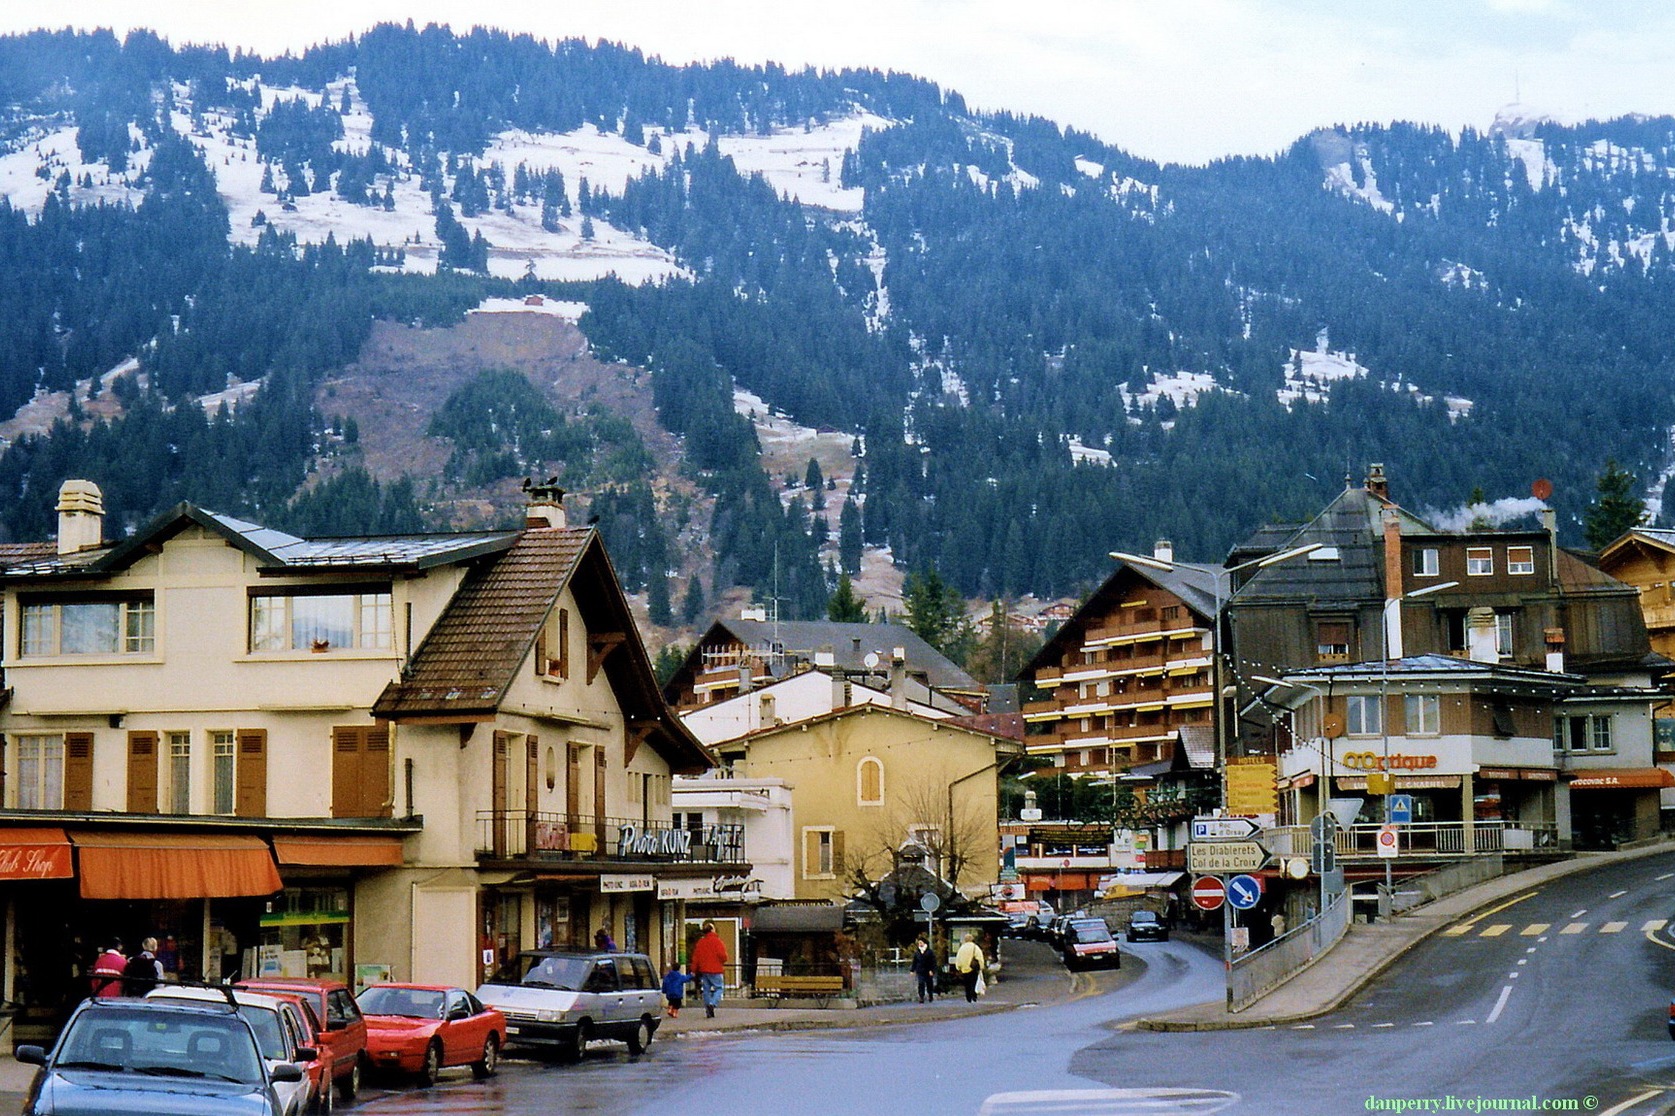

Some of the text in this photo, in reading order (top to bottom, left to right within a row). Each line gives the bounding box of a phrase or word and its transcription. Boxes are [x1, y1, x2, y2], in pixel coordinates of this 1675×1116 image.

[618, 823, 658, 857] Photo
[661, 828, 692, 854] KUNZ
[1192, 845, 1256, 856] Les Diablerets
[23, 849, 53, 878] Shop
[1192, 856, 1256, 868] Col de la Croix
